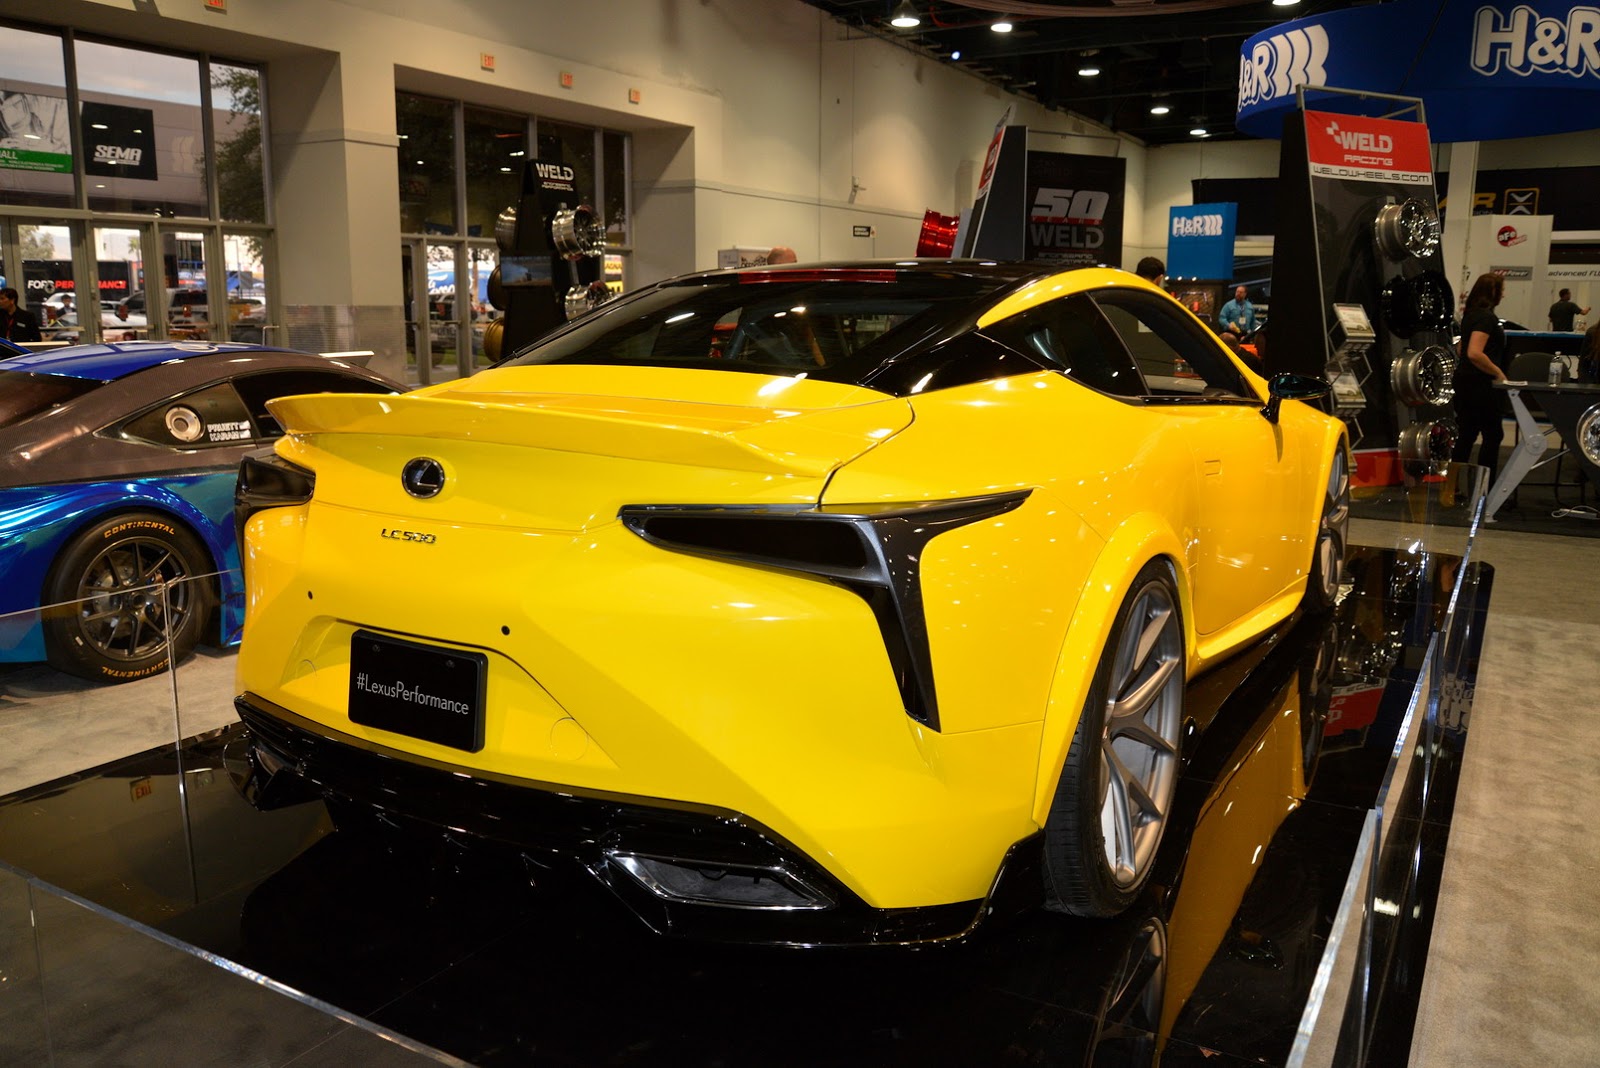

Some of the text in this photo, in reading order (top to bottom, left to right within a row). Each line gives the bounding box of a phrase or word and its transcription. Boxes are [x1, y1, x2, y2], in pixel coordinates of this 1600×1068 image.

[1471, 5, 1600, 79] H&R
[94, 144, 142, 161] SEMA
[1340, 131, 1393, 153] WELD
[1344, 154, 1393, 166] RACING
[535, 163, 574, 181] WELD
[1030, 187, 1110, 220] 50
[1029, 224, 1105, 249] WELD
[1172, 216, 1207, 237] H&R
[1548, 268, 1587, 277] advanced
[104, 521, 175, 538] CONTINENTAL
[357, 672, 469, 715] #LexusPerformance
